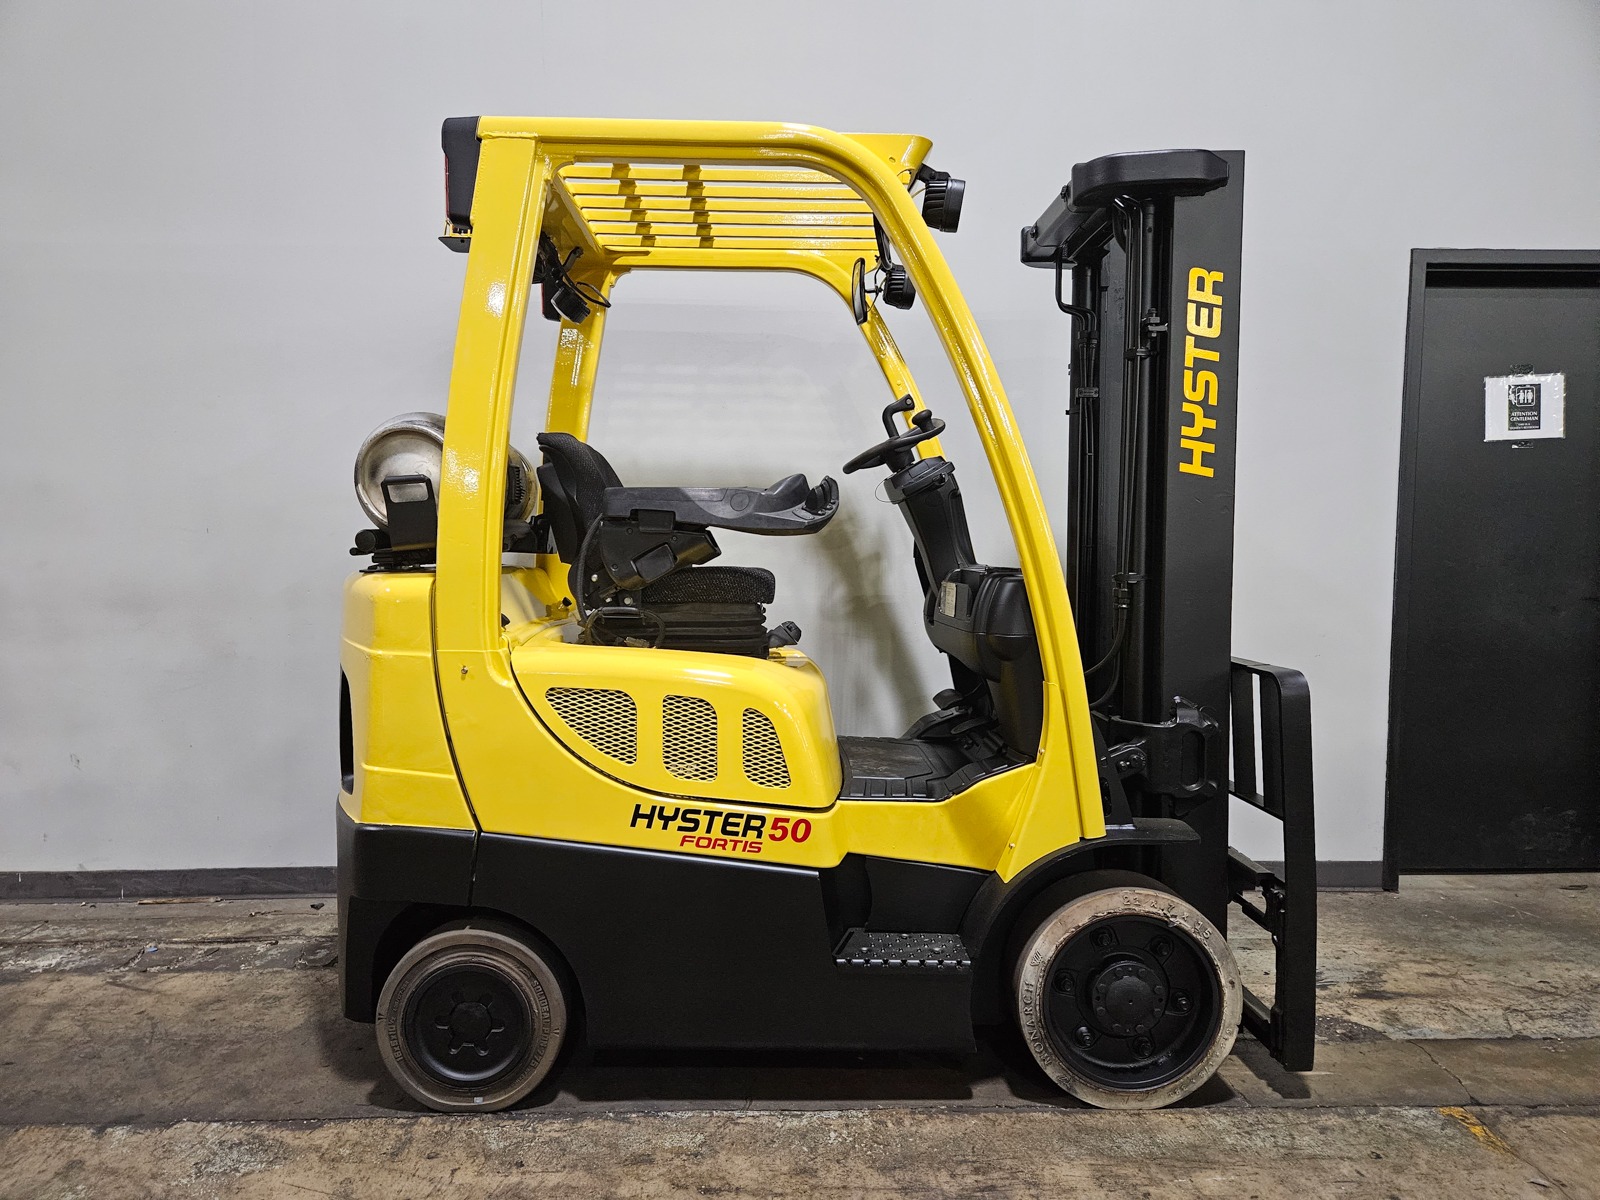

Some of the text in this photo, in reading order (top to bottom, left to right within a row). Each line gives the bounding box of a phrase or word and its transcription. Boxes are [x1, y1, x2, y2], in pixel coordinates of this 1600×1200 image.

[1179, 267, 1224, 478] HYSTER
[630, 803, 812, 843] HYSTER 50
[679, 835, 763, 854] FORTIS
[1194, 920, 1213, 939] 15
[532, 979, 551, 1024] SOLIDEAL
[1022, 982, 1052, 1066] MONARCH
